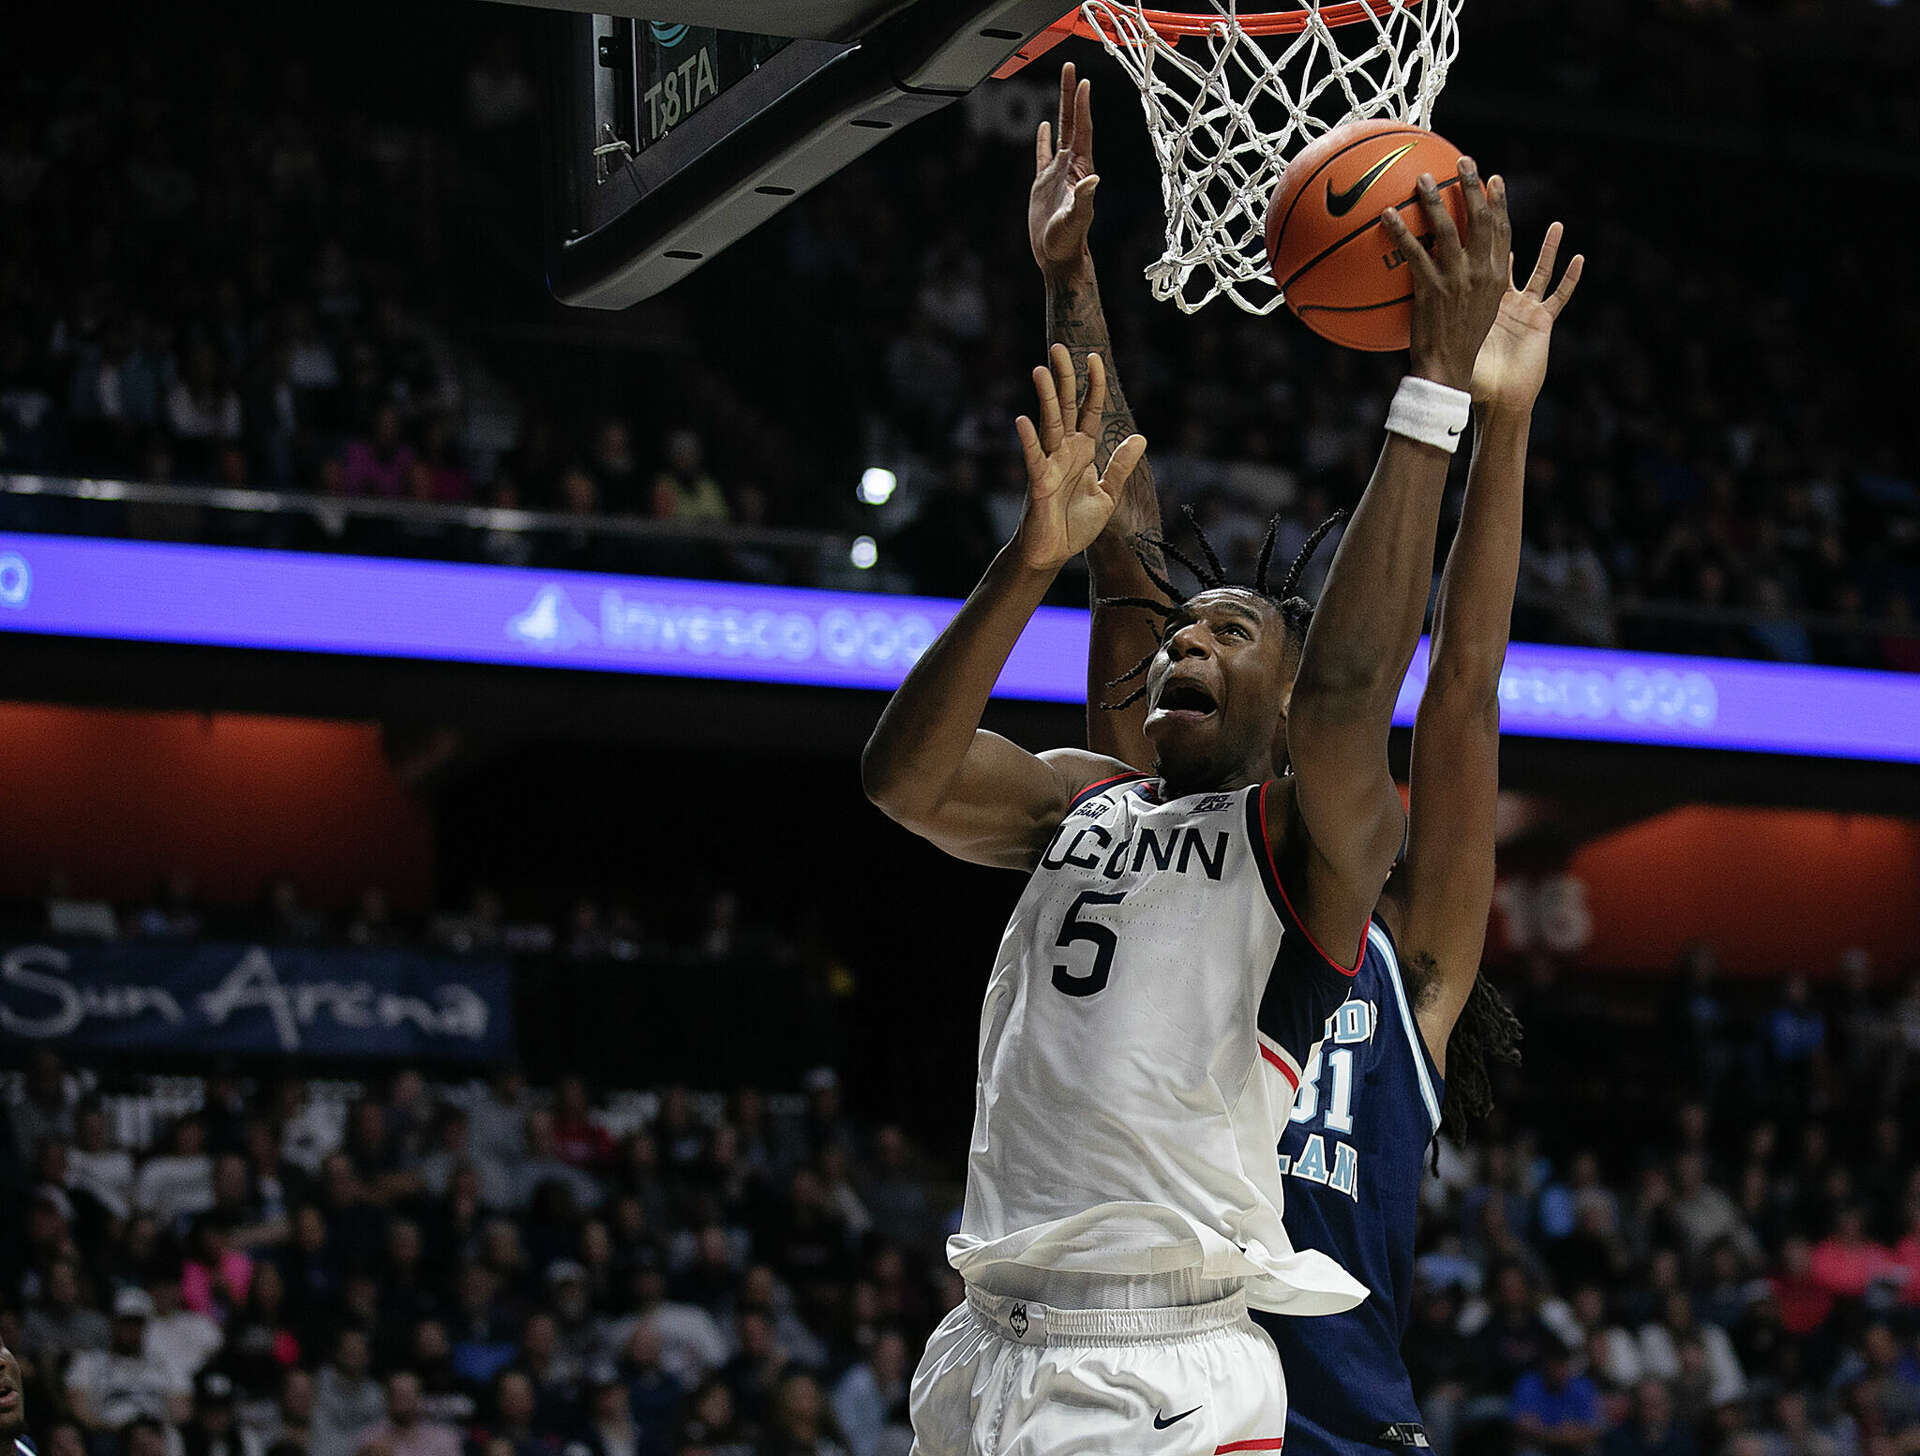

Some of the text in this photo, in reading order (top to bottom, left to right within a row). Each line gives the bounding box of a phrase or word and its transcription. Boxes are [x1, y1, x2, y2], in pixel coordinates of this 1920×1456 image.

[1040, 825, 1230, 882] UCONN
[0, 944, 488, 1052] Sun Arena
[1051, 891, 1128, 998] 5
